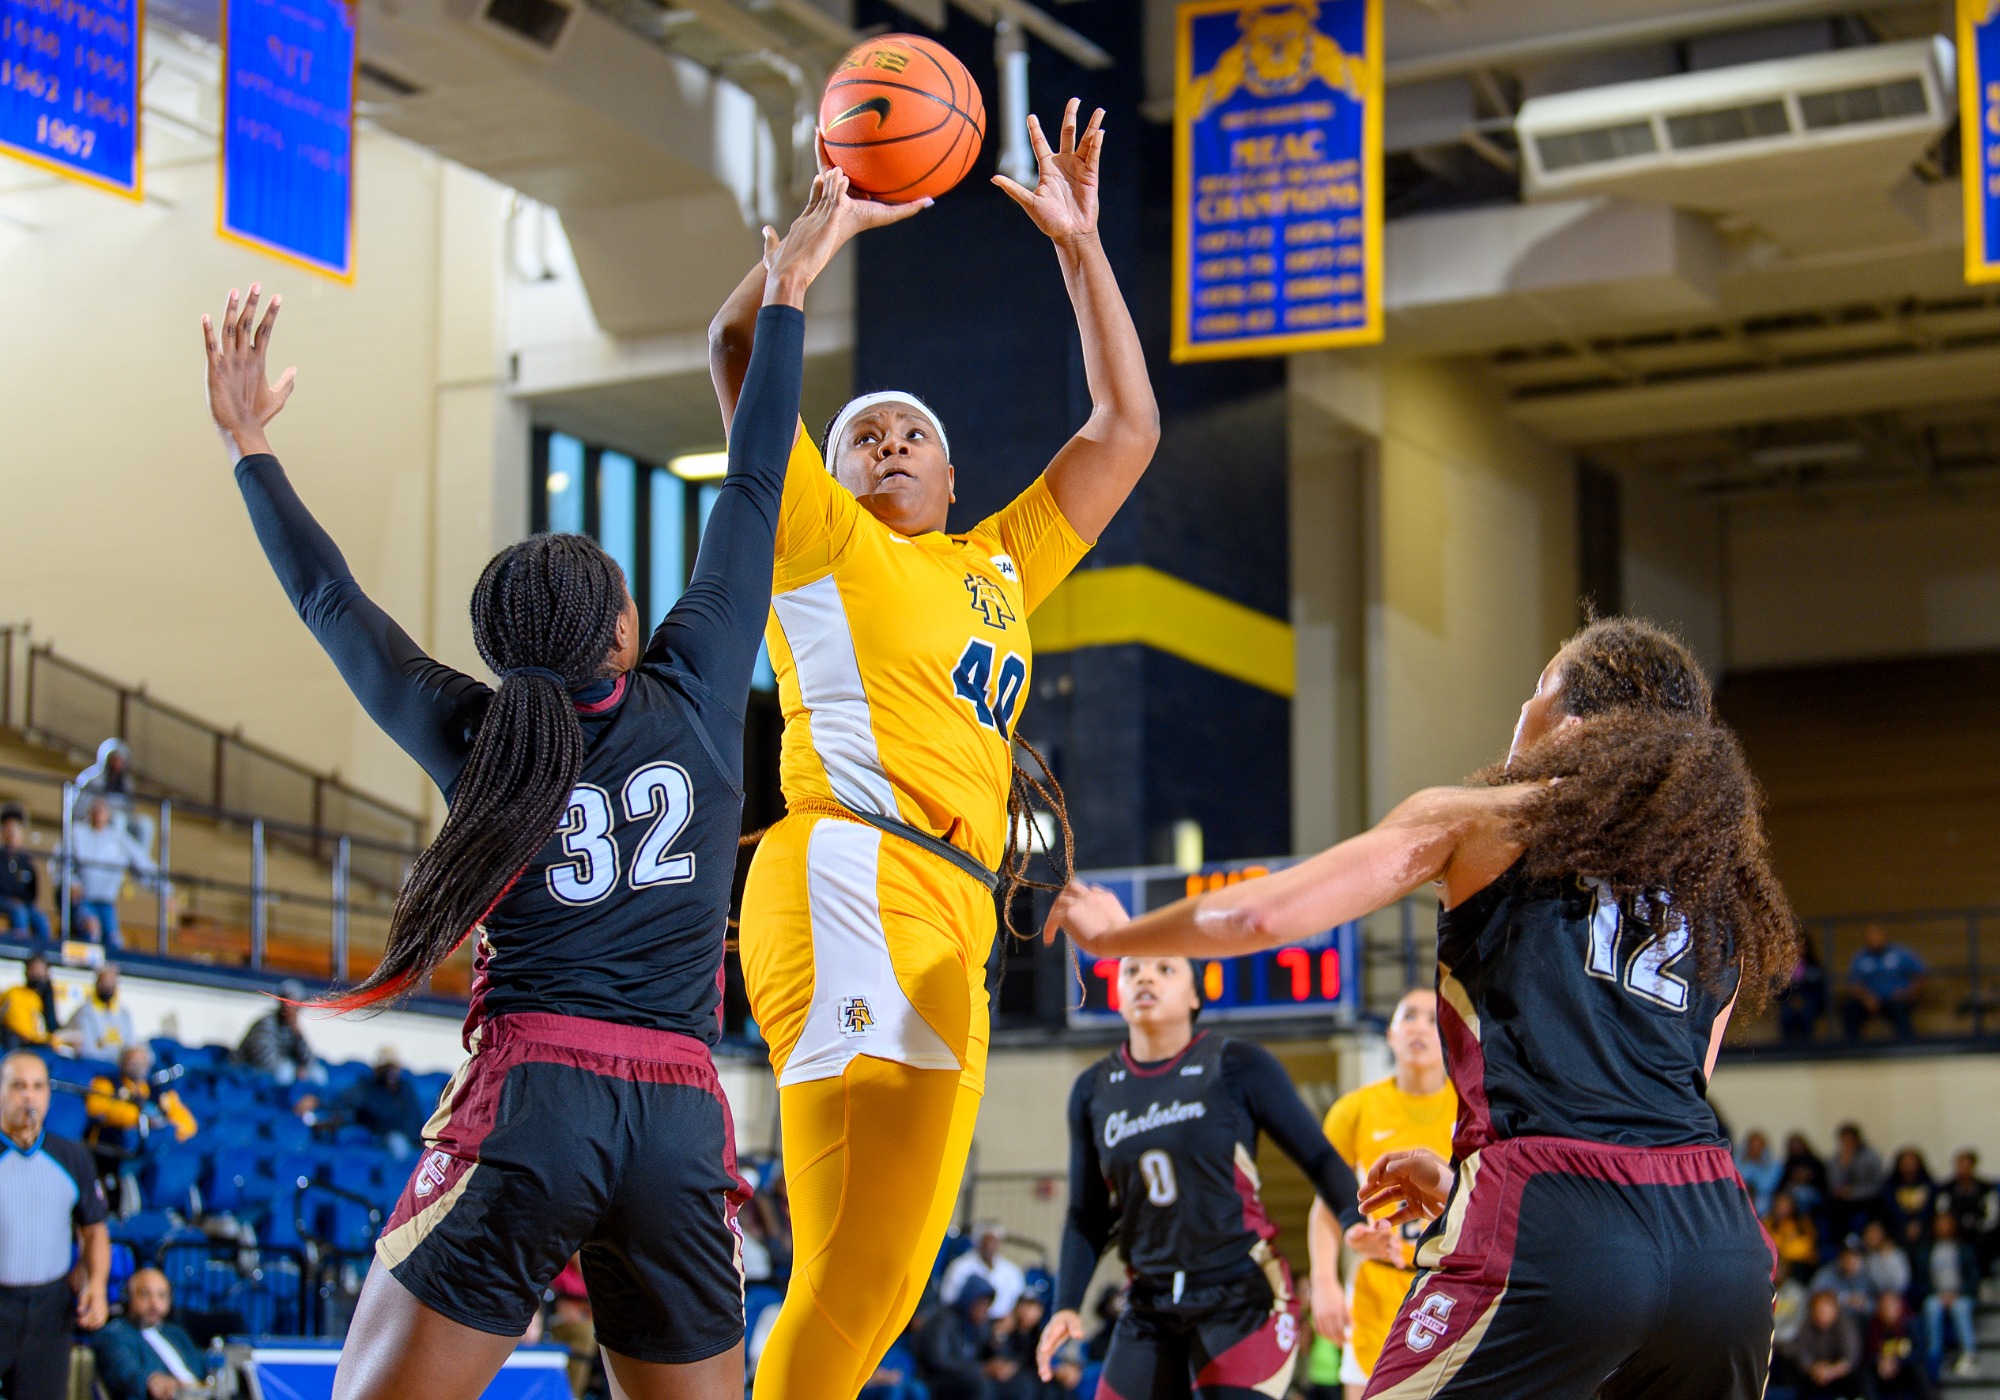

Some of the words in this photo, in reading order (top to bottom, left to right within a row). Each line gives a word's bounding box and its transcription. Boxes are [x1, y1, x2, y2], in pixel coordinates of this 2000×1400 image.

[1, 58, 60, 103] 1962
[36, 113, 96, 160] 1967
[950, 636, 1026, 745] 40
[546, 761, 695, 906] 32
[1575, 874, 1694, 1012] 12
[1276, 947, 1341, 1001] 71
[1103, 1099, 1206, 1149] Charleston
[1138, 1149, 1179, 1207] 0
